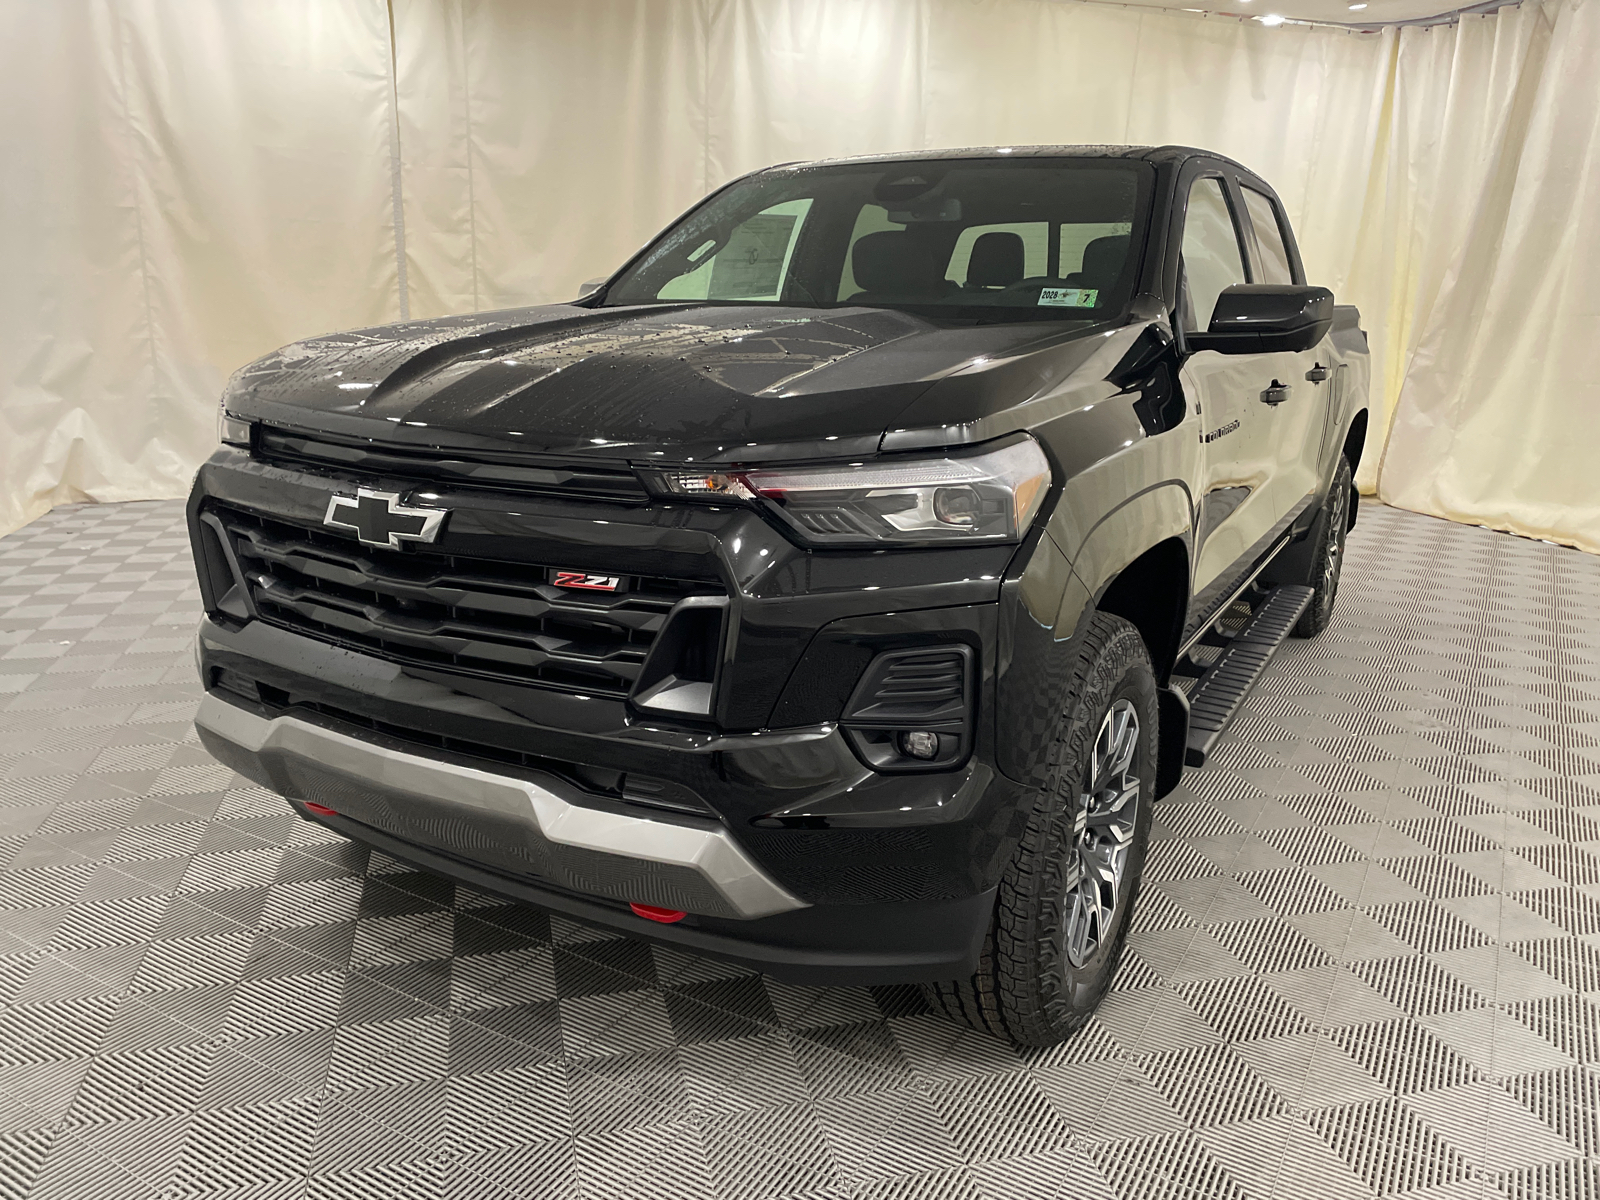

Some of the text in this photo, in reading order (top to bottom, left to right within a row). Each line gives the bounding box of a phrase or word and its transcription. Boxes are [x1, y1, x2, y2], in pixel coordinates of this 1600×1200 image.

[1041, 290, 1059, 300] 2028
[1082, 293, 1091, 304] 7
[553, 572, 620, 592] Z71
